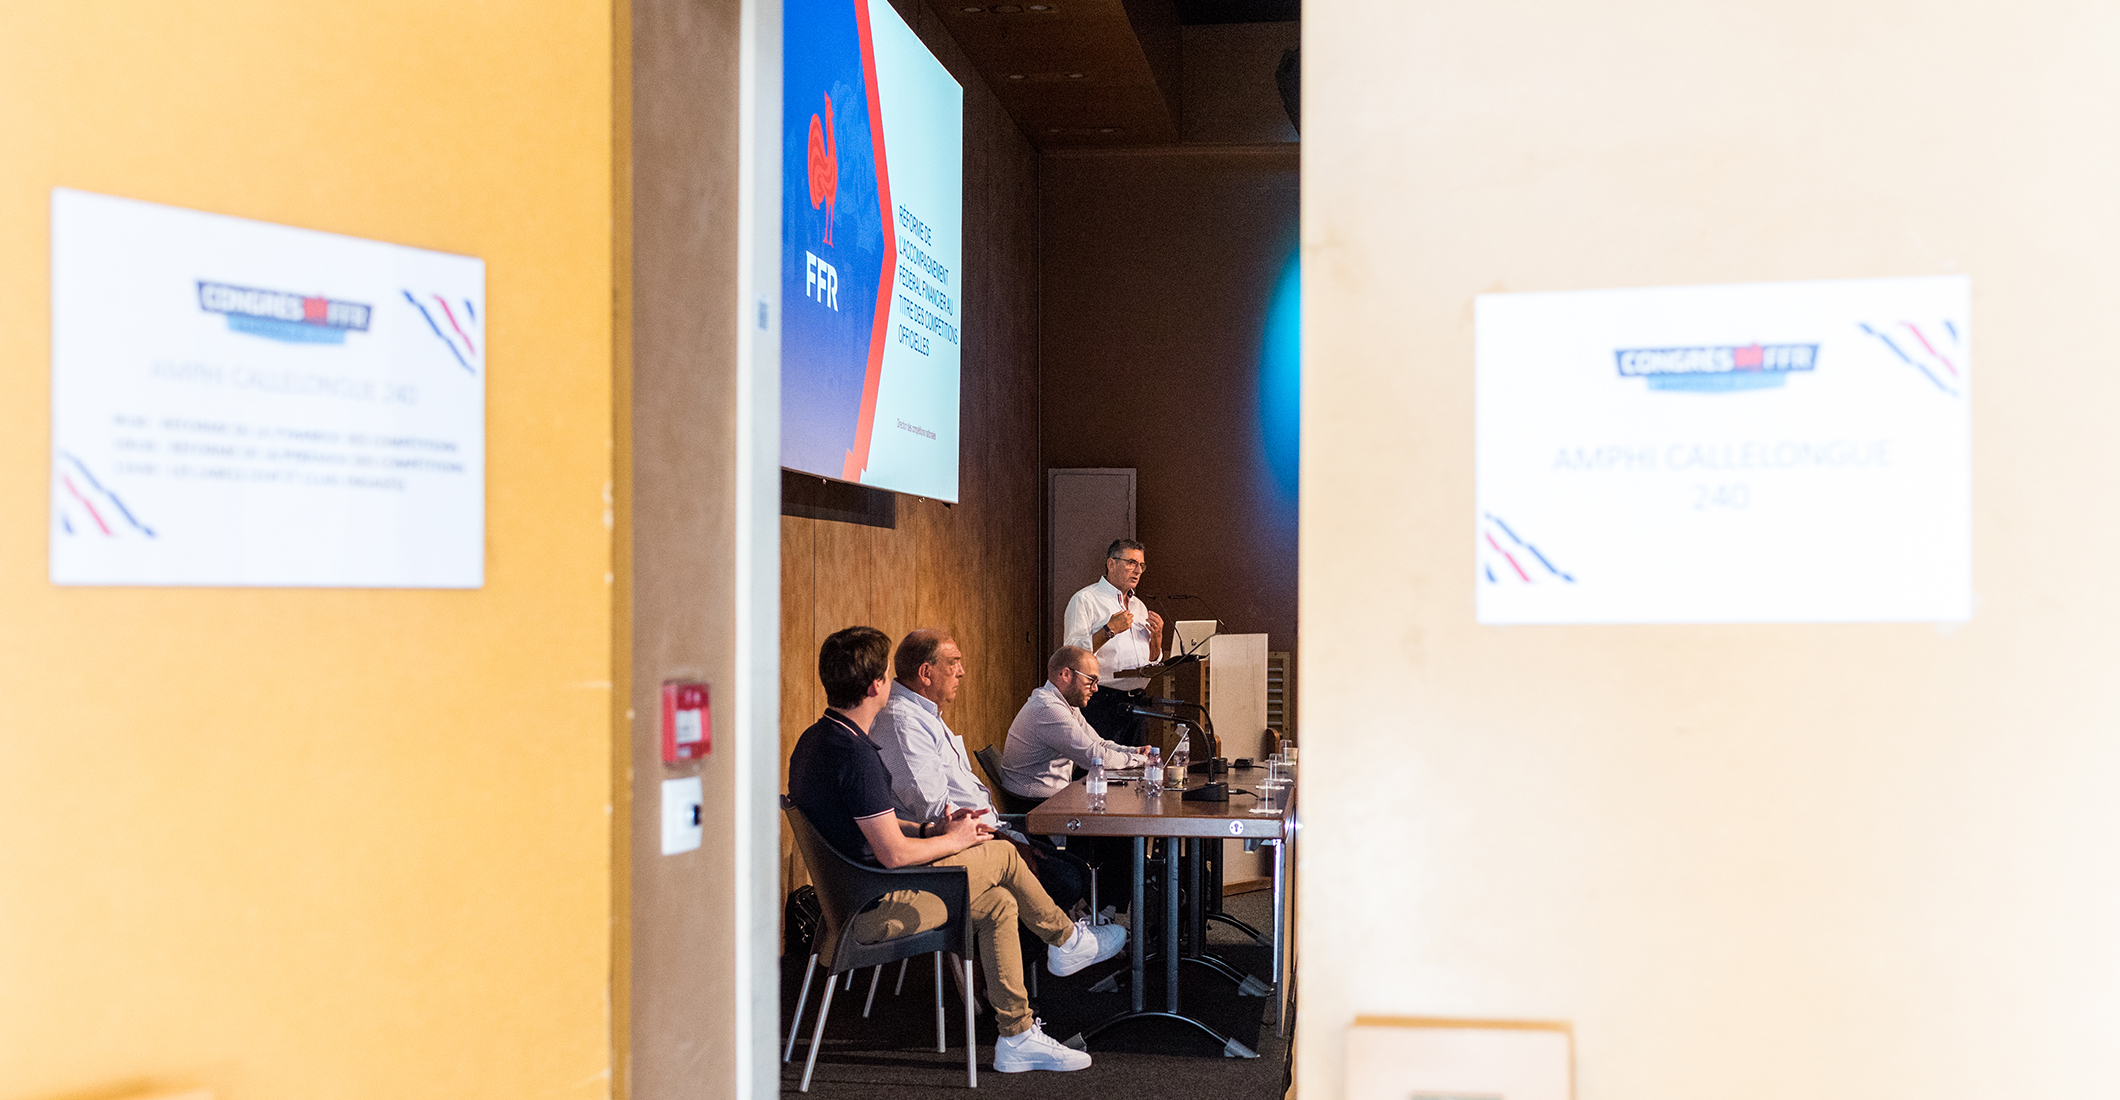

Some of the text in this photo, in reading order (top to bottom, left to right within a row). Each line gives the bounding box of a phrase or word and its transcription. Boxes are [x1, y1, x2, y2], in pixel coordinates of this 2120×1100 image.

[899, 204, 932, 247] RÉFORME DE
[806, 250, 839, 313] FFR
[899, 235, 949, 286] L'ACCOMPAGNEMENT
[899, 262, 954, 316] FÉDÉRAL FINANCIER AU
[898, 324, 930, 356] OFFICIELLES
[899, 294, 959, 345] TITRE DES COMPÉTITIONS
[1550, 438, 1890, 472] AMPHI CALLELONGUE
[1692, 482, 1752, 512] 240
